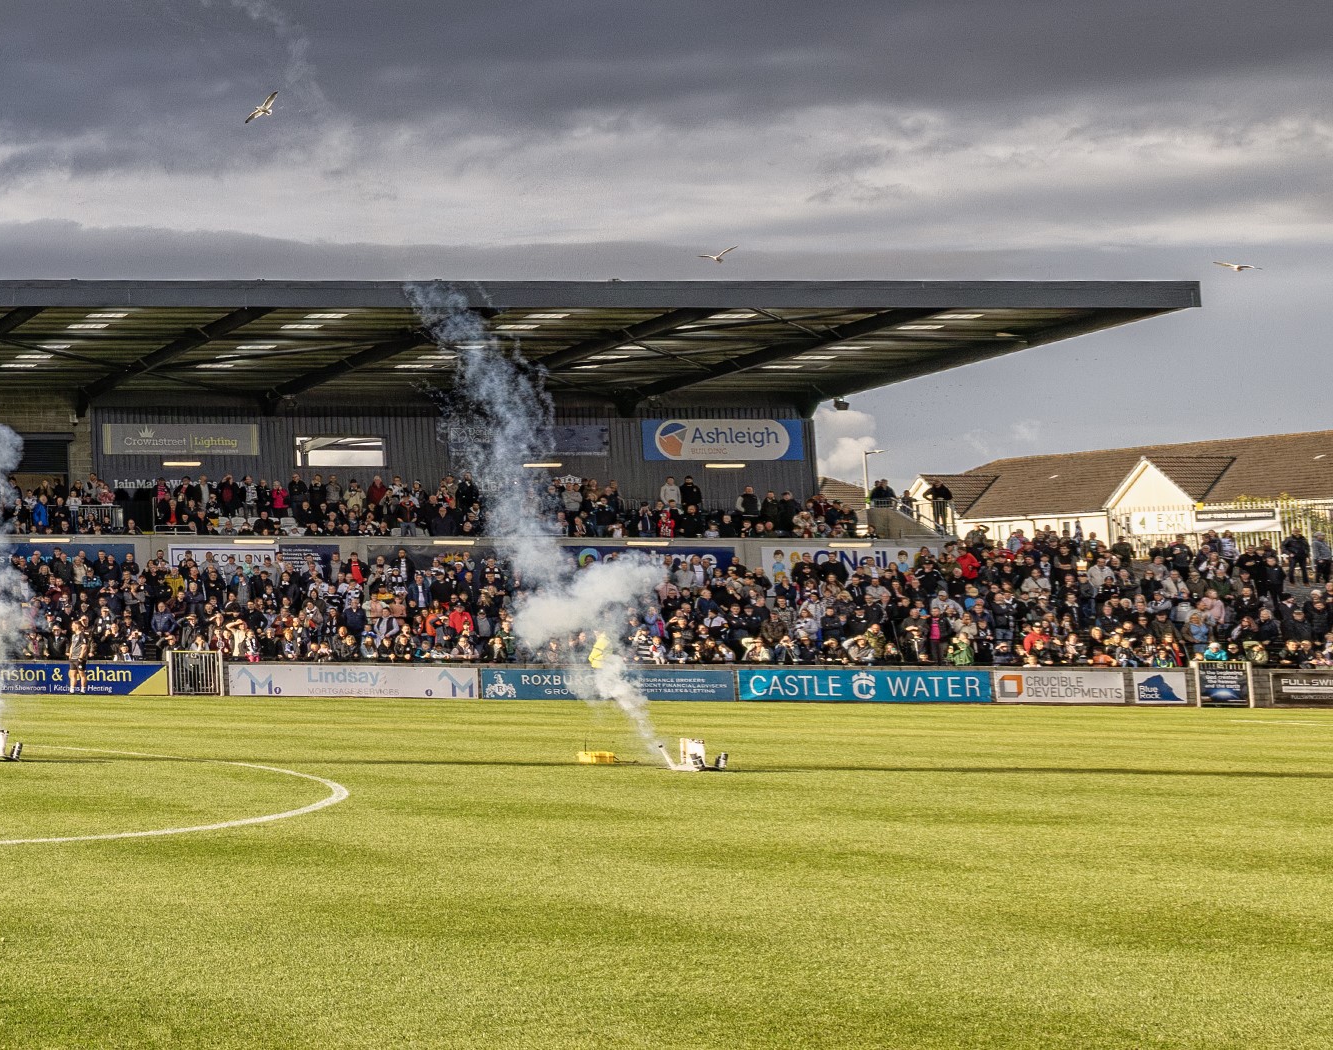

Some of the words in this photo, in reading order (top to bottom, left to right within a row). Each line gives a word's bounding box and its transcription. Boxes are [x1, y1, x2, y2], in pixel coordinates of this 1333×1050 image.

[124, 437, 186, 446] Crownstreet
[194, 437, 238, 447] Lighting
[691, 427, 779, 448] Ashleigh
[1157, 514, 1185, 522] EXIT
[1157, 523, 1186, 532] LMN
[52, 668, 63, 682] &
[307, 667, 379, 686] Lindsay
[750, 675, 842, 697] CASTLE
[886, 676, 980, 697] WATER
[1026, 676, 1083, 687] CRUCIBLE
[1026, 687, 1123, 699] DEVELOPMENTS
